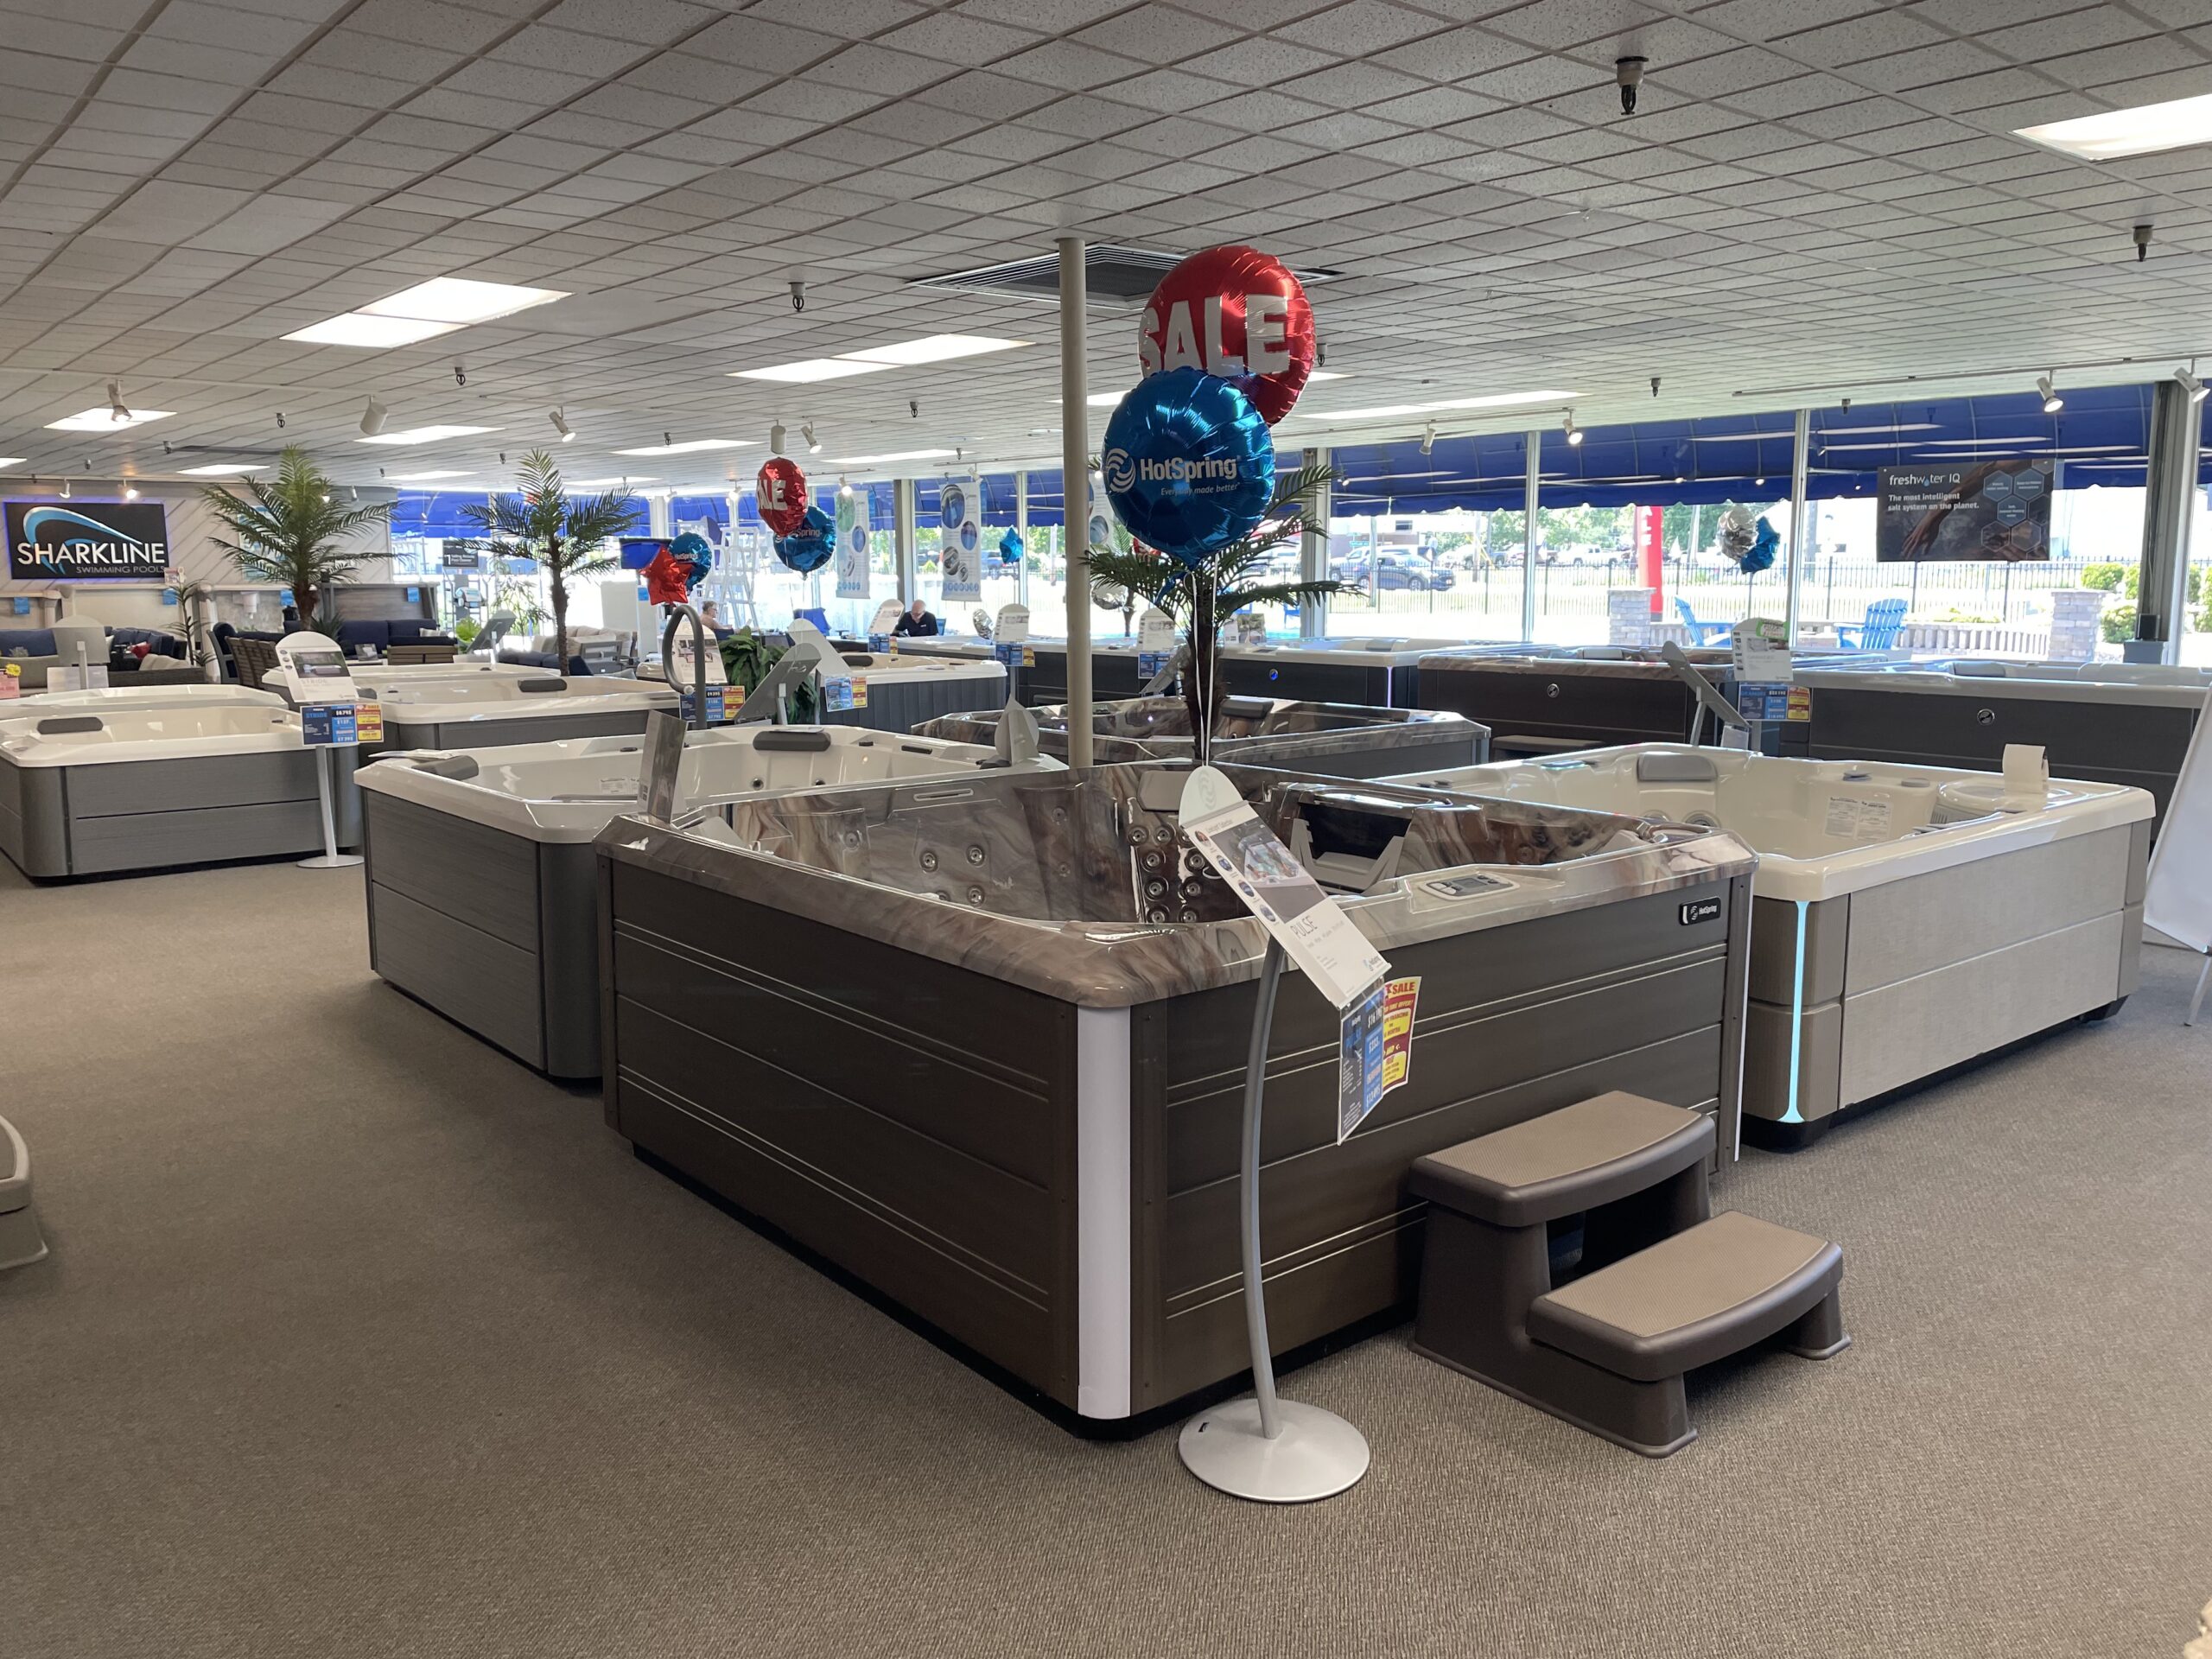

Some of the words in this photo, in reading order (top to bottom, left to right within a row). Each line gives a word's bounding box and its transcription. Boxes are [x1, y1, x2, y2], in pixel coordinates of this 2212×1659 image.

[1138, 293, 1291, 378] SALE
[1140, 455, 1236, 483] HotSpring
[1889, 474, 1946, 486] freshwter
[1948, 473, 1960, 484] IQ
[1194, 486, 1213, 495] made
[1216, 483, 1238, 493] better
[1922, 493, 1960, 501] intelligent
[1954, 501, 1980, 511] planet.
[17, 542, 165, 564] SHARKLINE
[1289, 915, 1318, 939] PULSE
[1392, 982, 1415, 994] SALE
